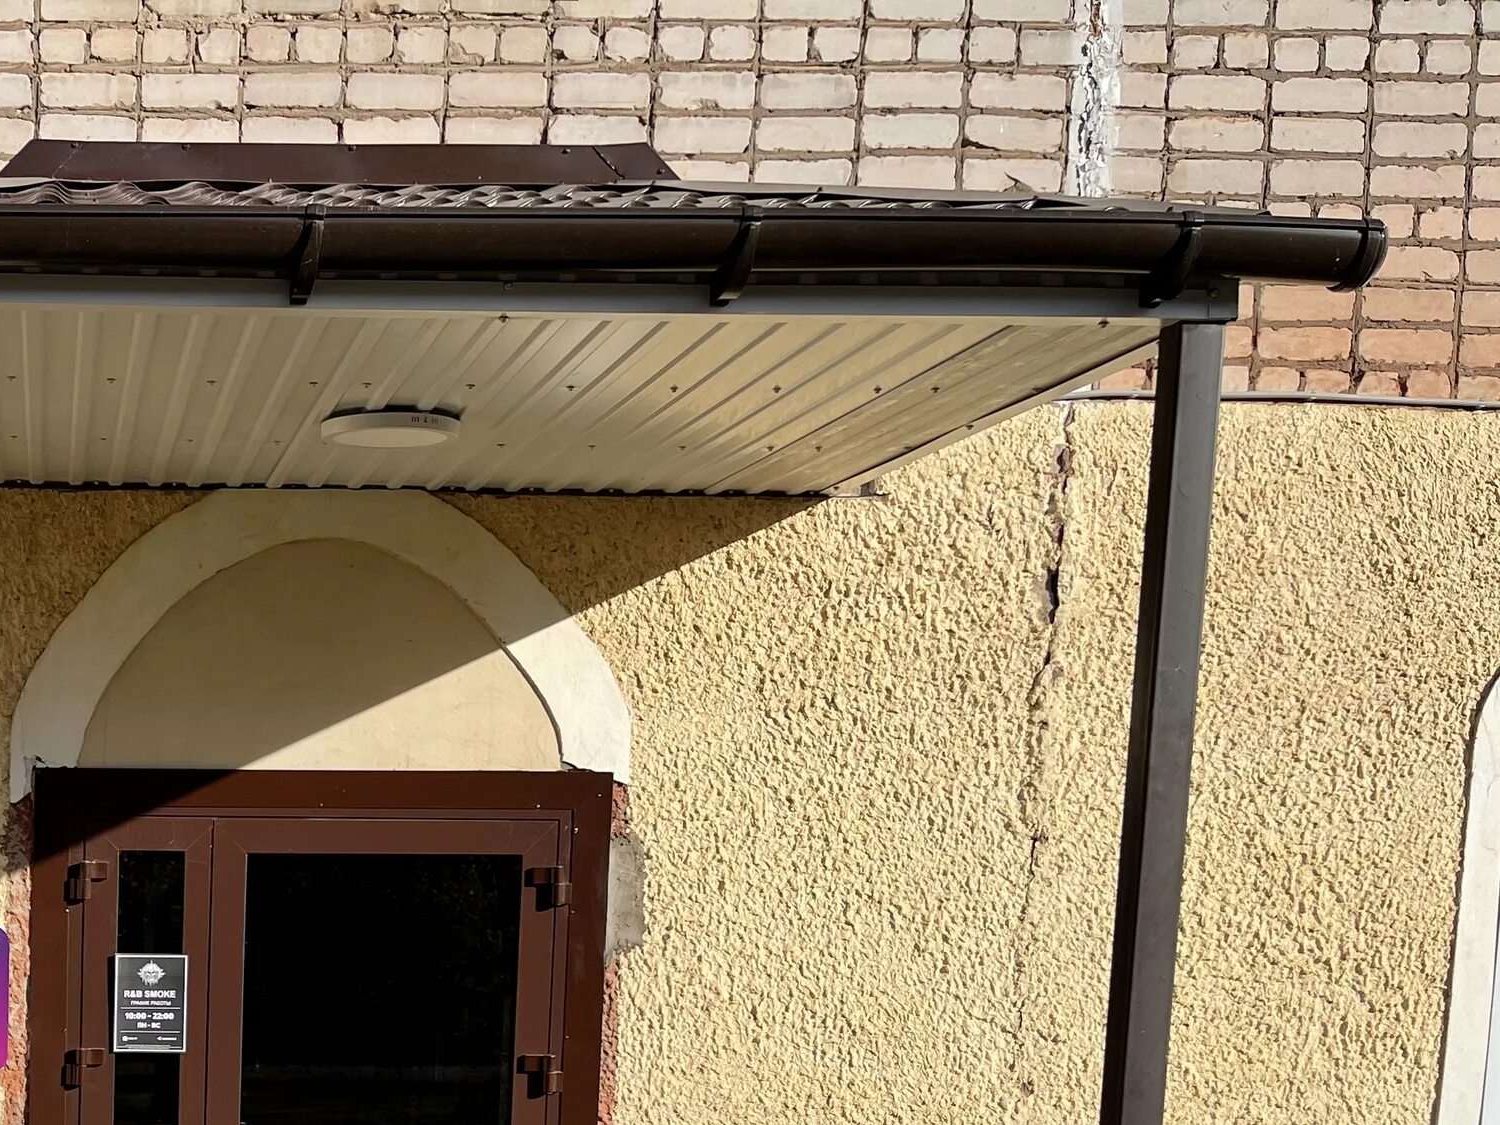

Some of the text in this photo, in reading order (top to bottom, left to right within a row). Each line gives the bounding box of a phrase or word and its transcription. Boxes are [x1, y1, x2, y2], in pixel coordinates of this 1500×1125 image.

[123, 990, 176, 998] R&B SMOKE
[124, 1012, 147, 1020] 10:00
[152, 1012, 175, 1020] 22:00
